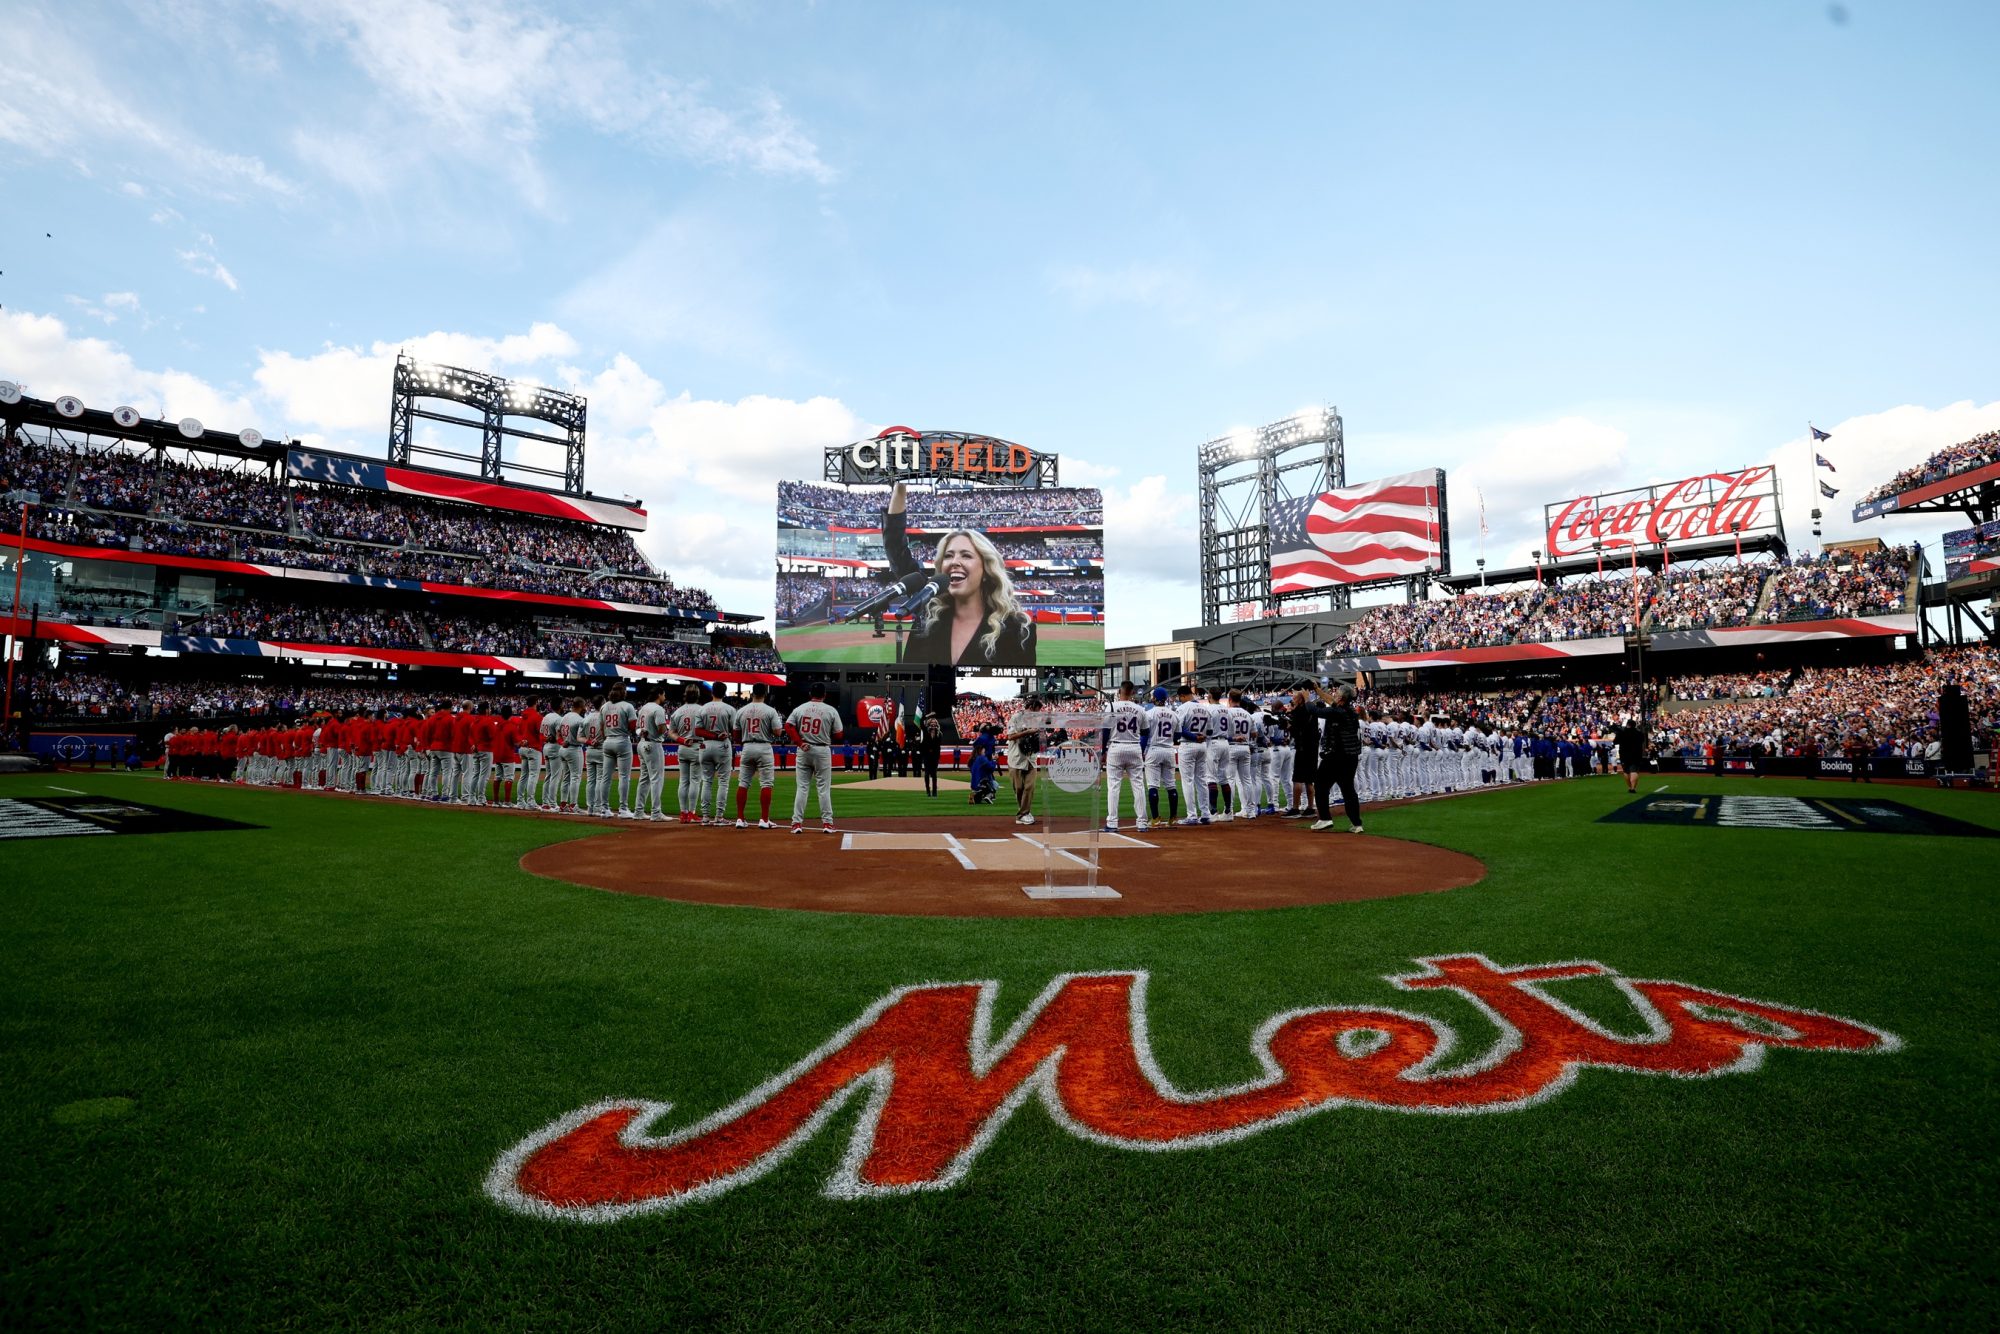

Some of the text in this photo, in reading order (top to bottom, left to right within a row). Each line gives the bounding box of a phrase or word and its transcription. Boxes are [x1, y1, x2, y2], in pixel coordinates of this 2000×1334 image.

[0, 386, 16, 398] 37
[243, 432, 258, 444] 42
[852, 433, 1033, 473] citi FIELD
[991, 668, 1037, 677] SAMSUNG
[605, 713, 619, 728] 28
[683, 717, 691, 732] 3
[709, 716, 717, 731] 7
[746, 717, 761, 733] 12
[801, 716, 822, 735] 59
[1116, 716, 1138, 734] 64
[1189, 716, 1209, 732] 27
[1219, 716, 1228, 732] 9
[1234, 719, 1249, 735] 20
[1157, 721, 1172, 738] 12
[1905, 763, 1924, 771] NLDS
[481, 952, 1904, 1222] Mets
